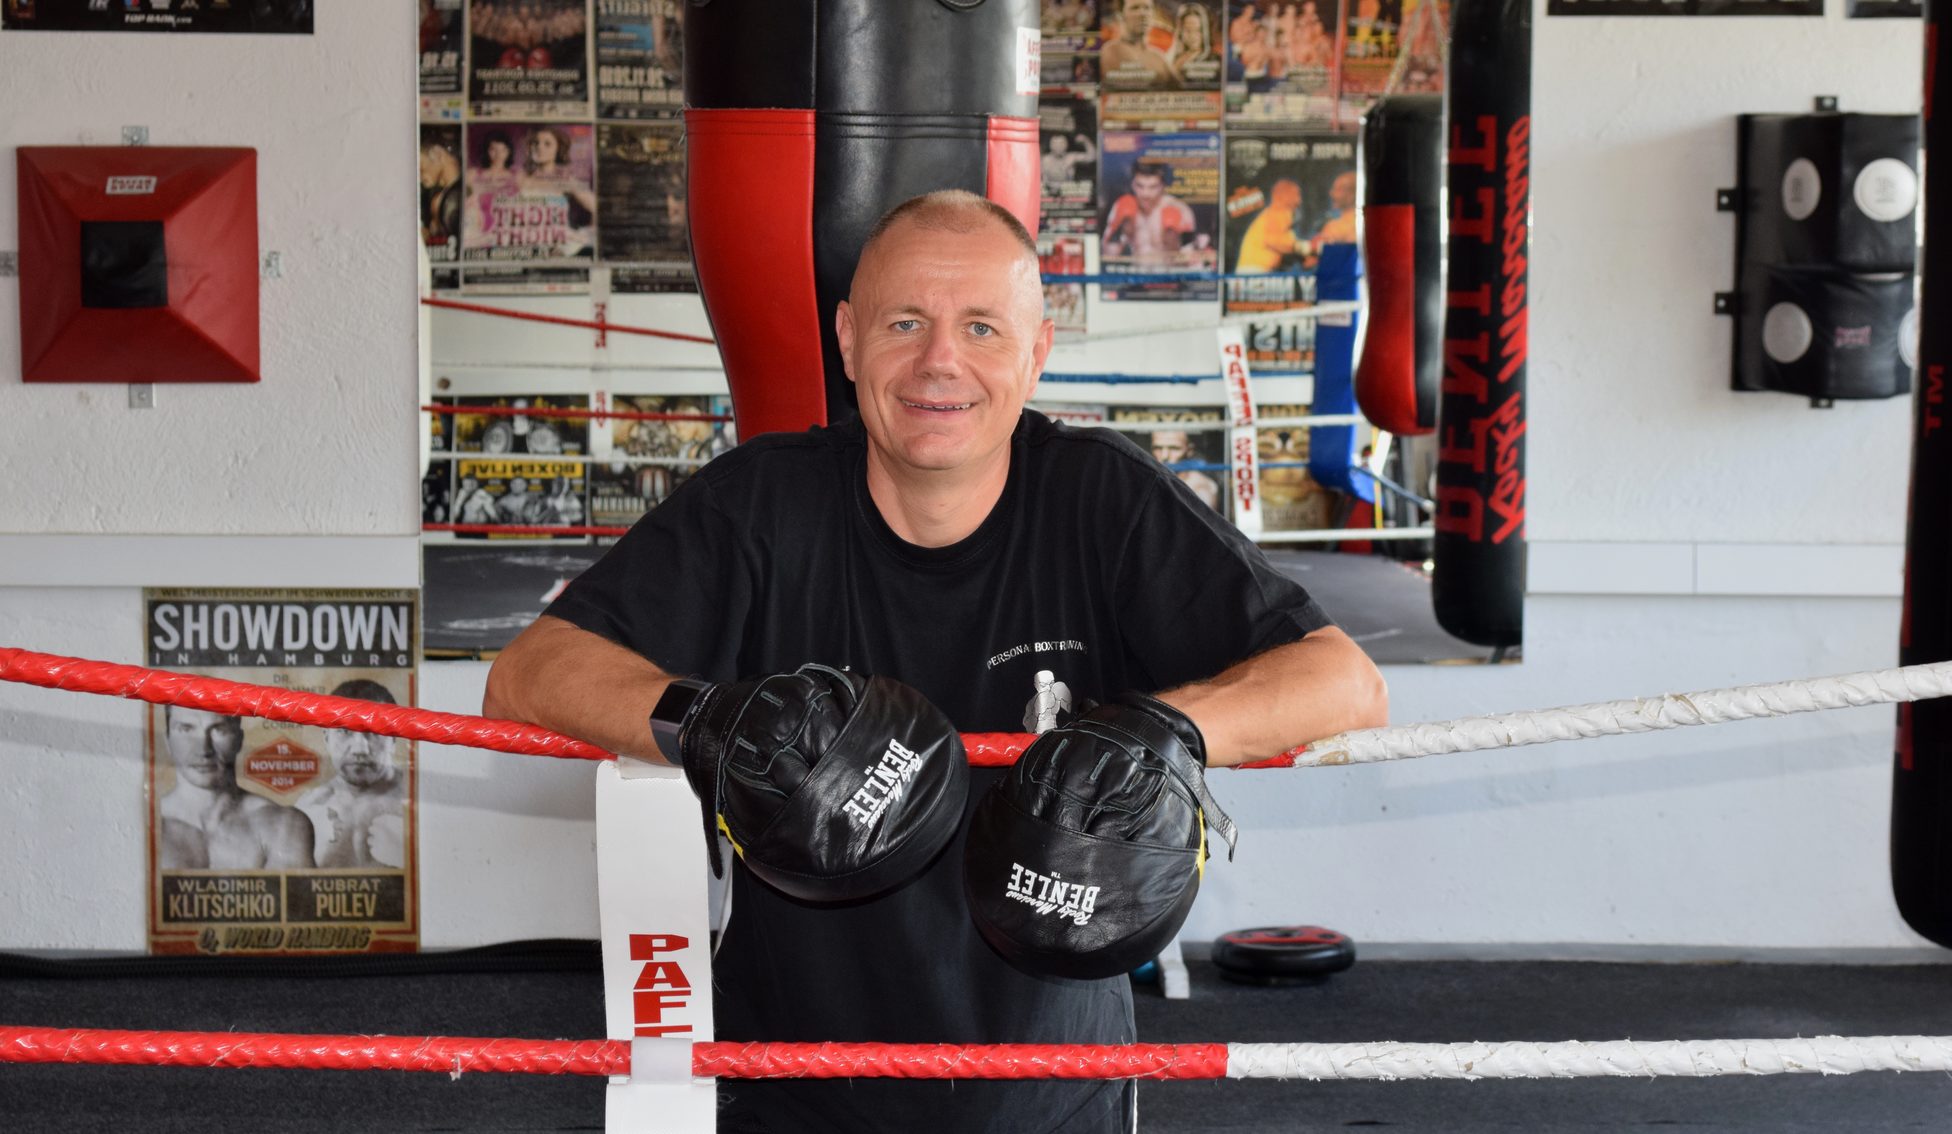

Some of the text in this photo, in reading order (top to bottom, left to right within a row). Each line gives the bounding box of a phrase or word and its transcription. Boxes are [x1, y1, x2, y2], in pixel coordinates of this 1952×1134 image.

[161, 588, 400, 598] WELTMEISTERSCHAFT IM SCHWERGEWICHT
[153, 603, 408, 651] SHOWDOWN
[155, 654, 408, 665] IN HAMBURG
[986, 643, 1032, 670] PERSONA
[250, 761, 315, 770] NOVEMBER
[272, 777, 294, 786] 2014
[842, 738, 914, 825] BENLEE
[178, 880, 267, 892] WLADIMIR
[311, 879, 382, 892] KUBRAT
[1006, 862, 1101, 914] BENLEE
[169, 893, 275, 918] KLITSCHKO
[316, 893, 378, 918] PULEV
[1005, 890, 1091, 927] Rocky Marciano
[224, 927, 284, 949] WORLD
[285, 927, 371, 949] HAMBURG
